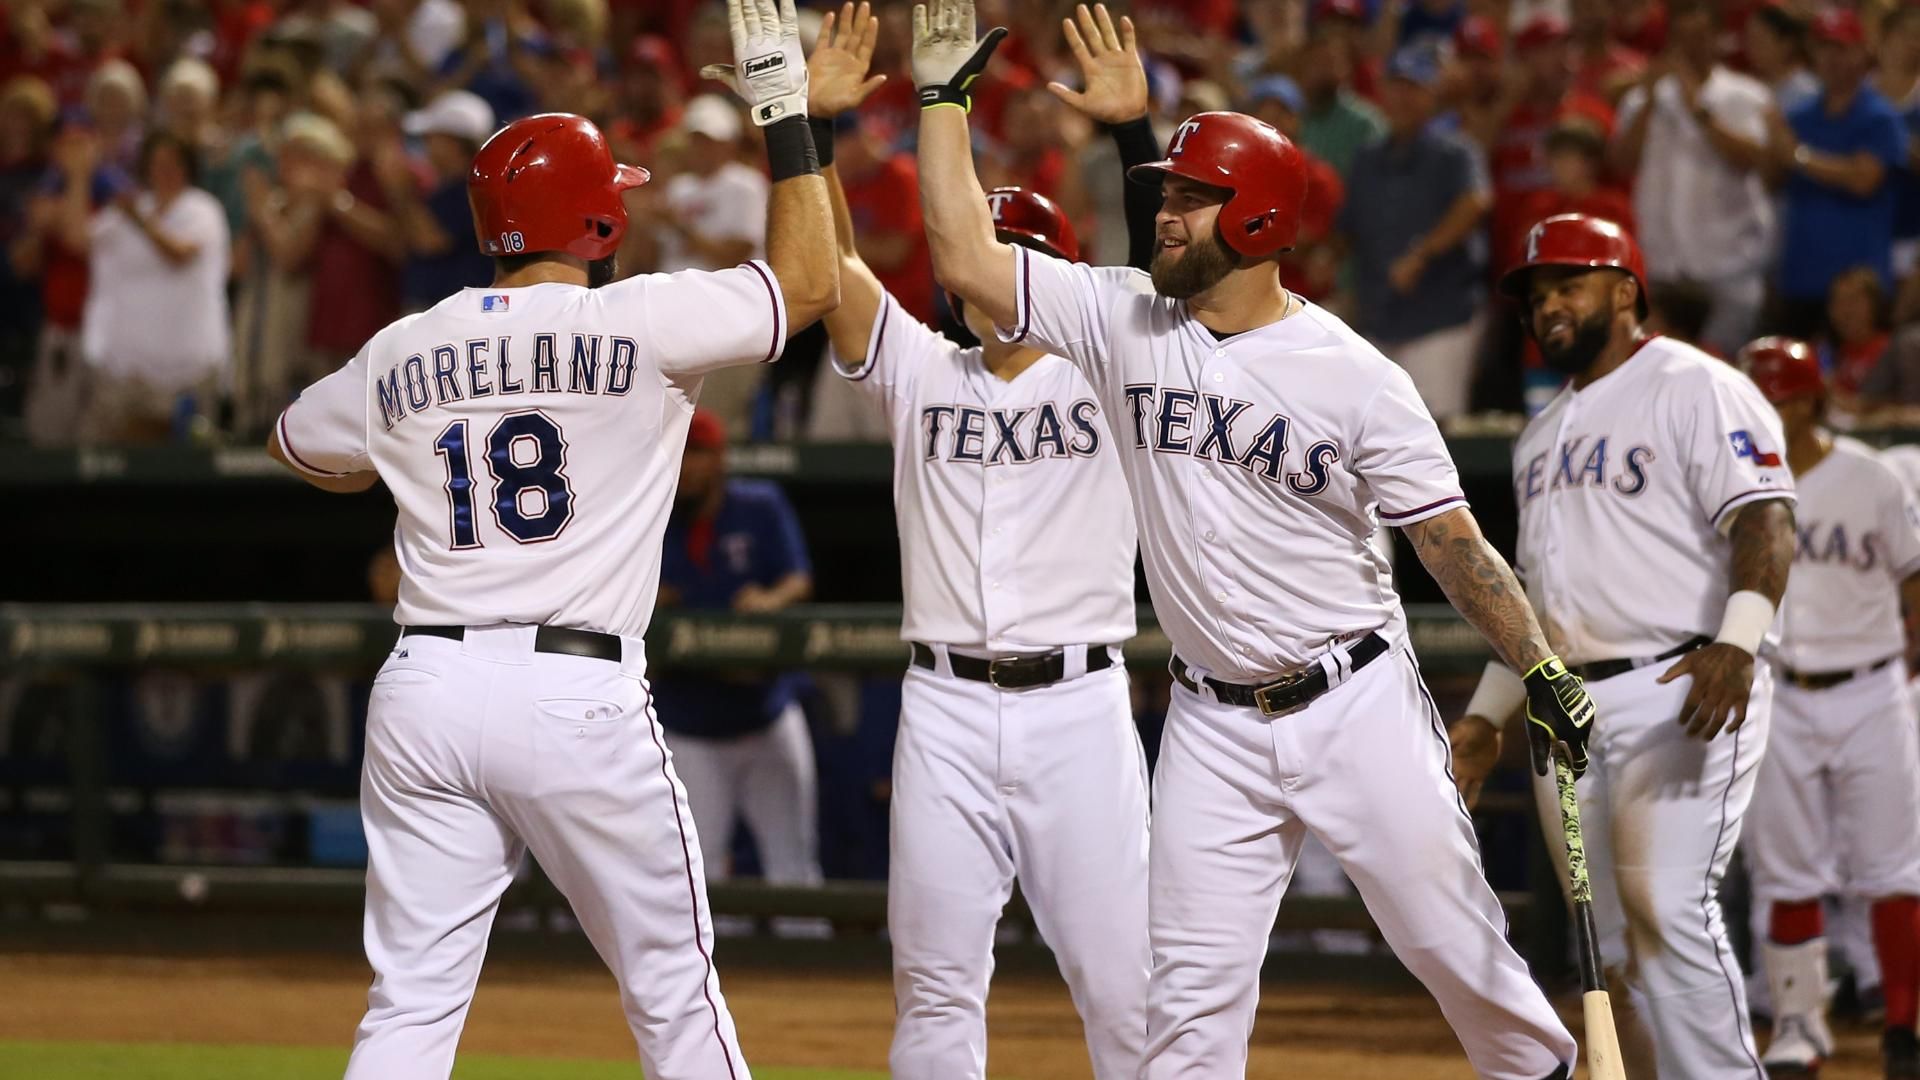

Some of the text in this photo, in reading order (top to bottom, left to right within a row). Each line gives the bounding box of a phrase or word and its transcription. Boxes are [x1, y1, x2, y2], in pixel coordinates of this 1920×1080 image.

[1171, 120, 1201, 154] T
[985, 192, 1013, 220] T
[501, 231, 524, 252] 18
[376, 332, 639, 432] MORELAND
[921, 397, 1101, 468] TEXAS
[1124, 383, 1340, 496] TEXAS
[433, 408, 577, 551] 18
[1793, 521, 1883, 572] XAS
